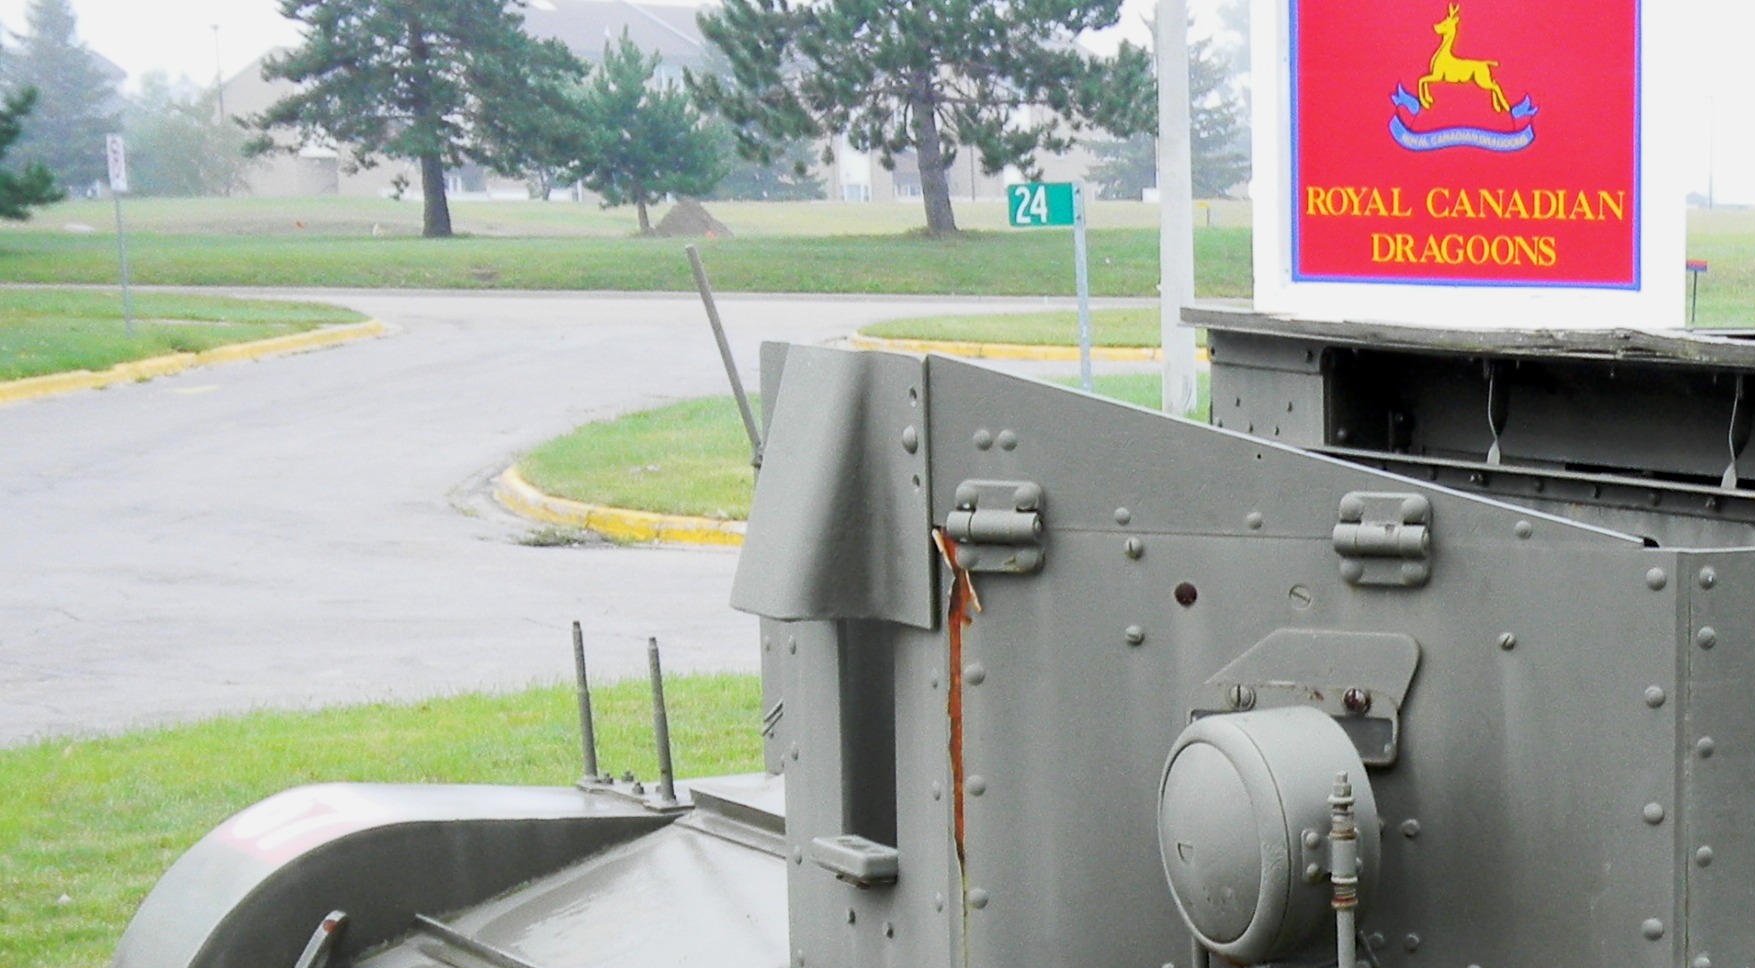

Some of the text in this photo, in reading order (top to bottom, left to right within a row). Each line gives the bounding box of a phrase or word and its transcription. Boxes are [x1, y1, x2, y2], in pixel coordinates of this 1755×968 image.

[1014, 185, 1048, 225] 24
[1306, 186, 1626, 221] ROYAL CANADIAN
[1371, 233, 1557, 267] DRAGOONS
